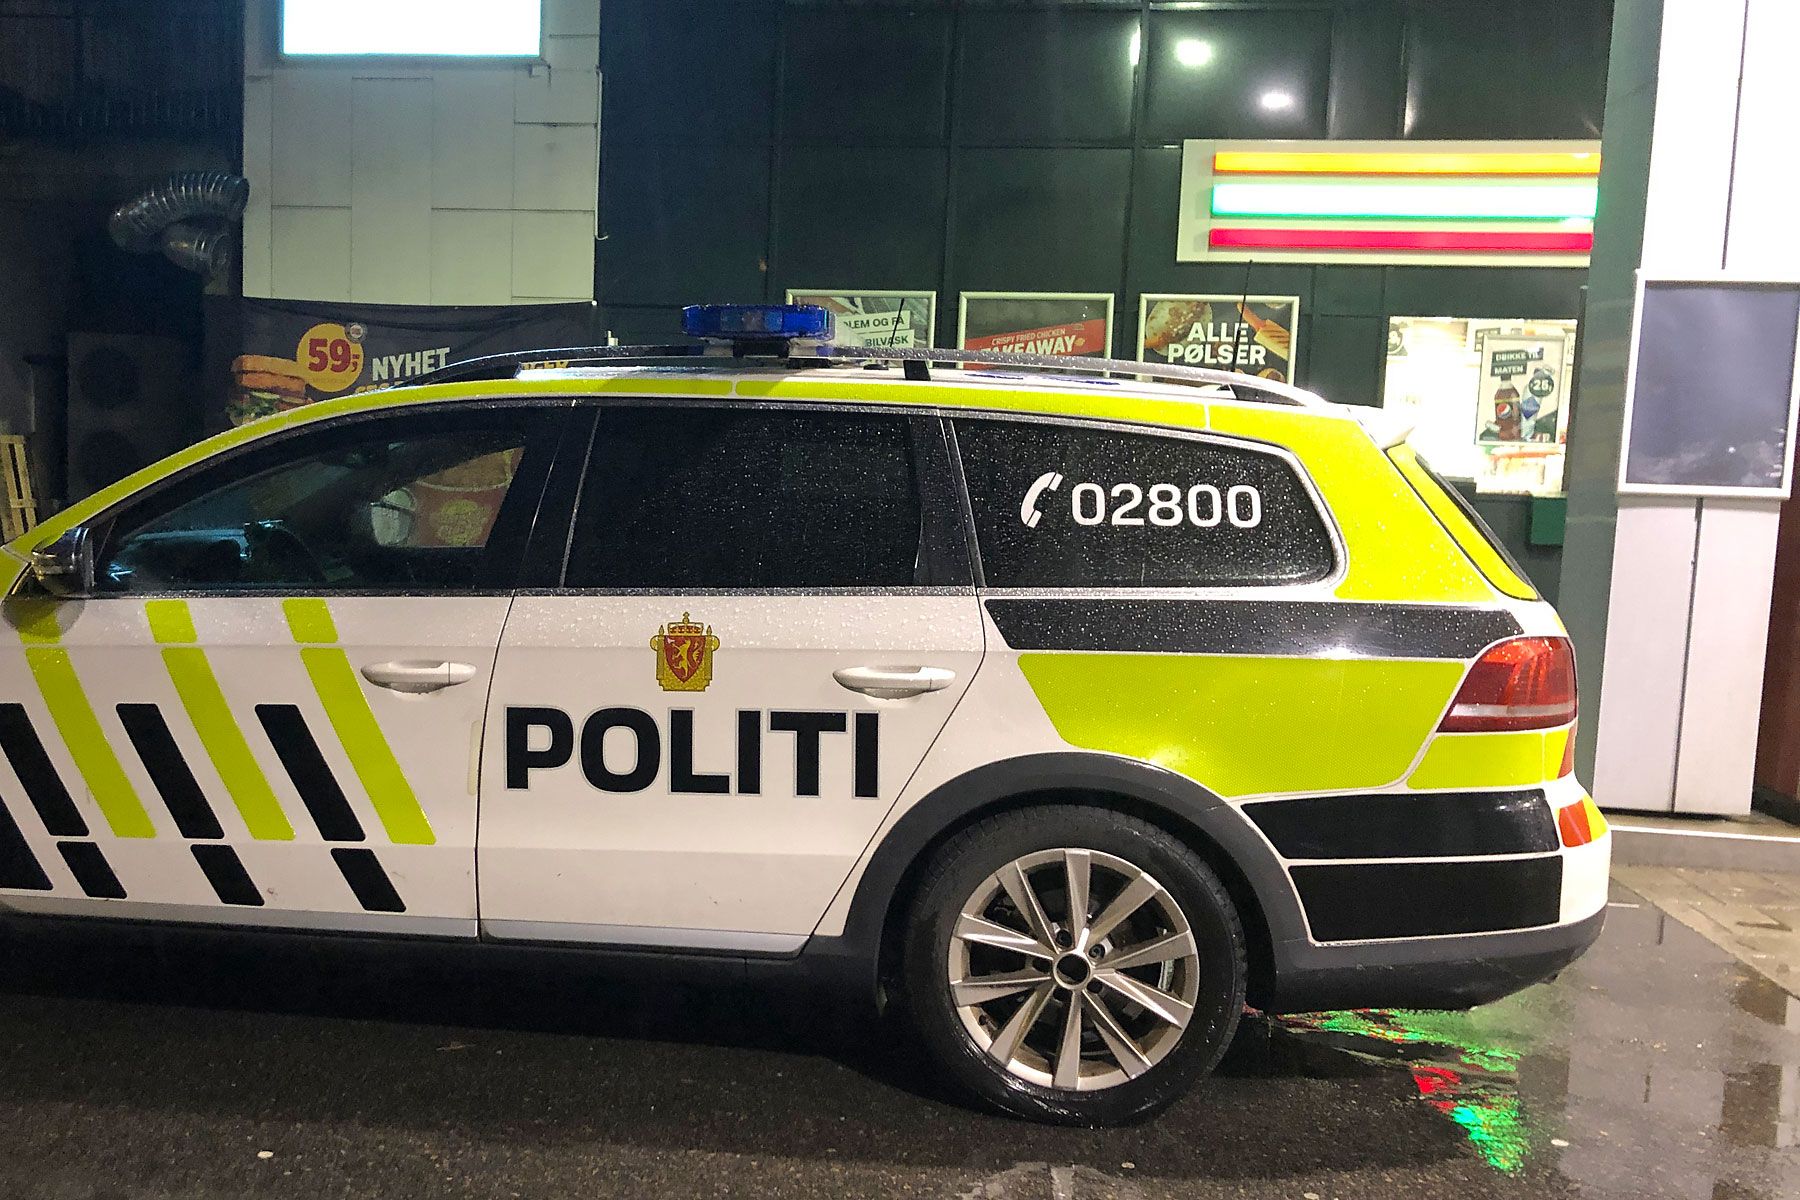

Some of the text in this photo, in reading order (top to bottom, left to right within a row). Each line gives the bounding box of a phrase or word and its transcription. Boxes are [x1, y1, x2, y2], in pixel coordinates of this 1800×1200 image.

[872, 318, 889, 327] OG
[1187, 322, 1248, 342] ALLE
[865, 335, 909, 347] BILVASK
[991, 328, 1066, 346] CRISPY FRIED CHICKEN
[372, 347, 450, 381] NYHET
[1168, 343, 1266, 365] PØLSER
[1494, 365, 1524, 375] MATEN
[1071, 483, 1262, 528] 02800
[505, 706, 880, 798] POLITI
